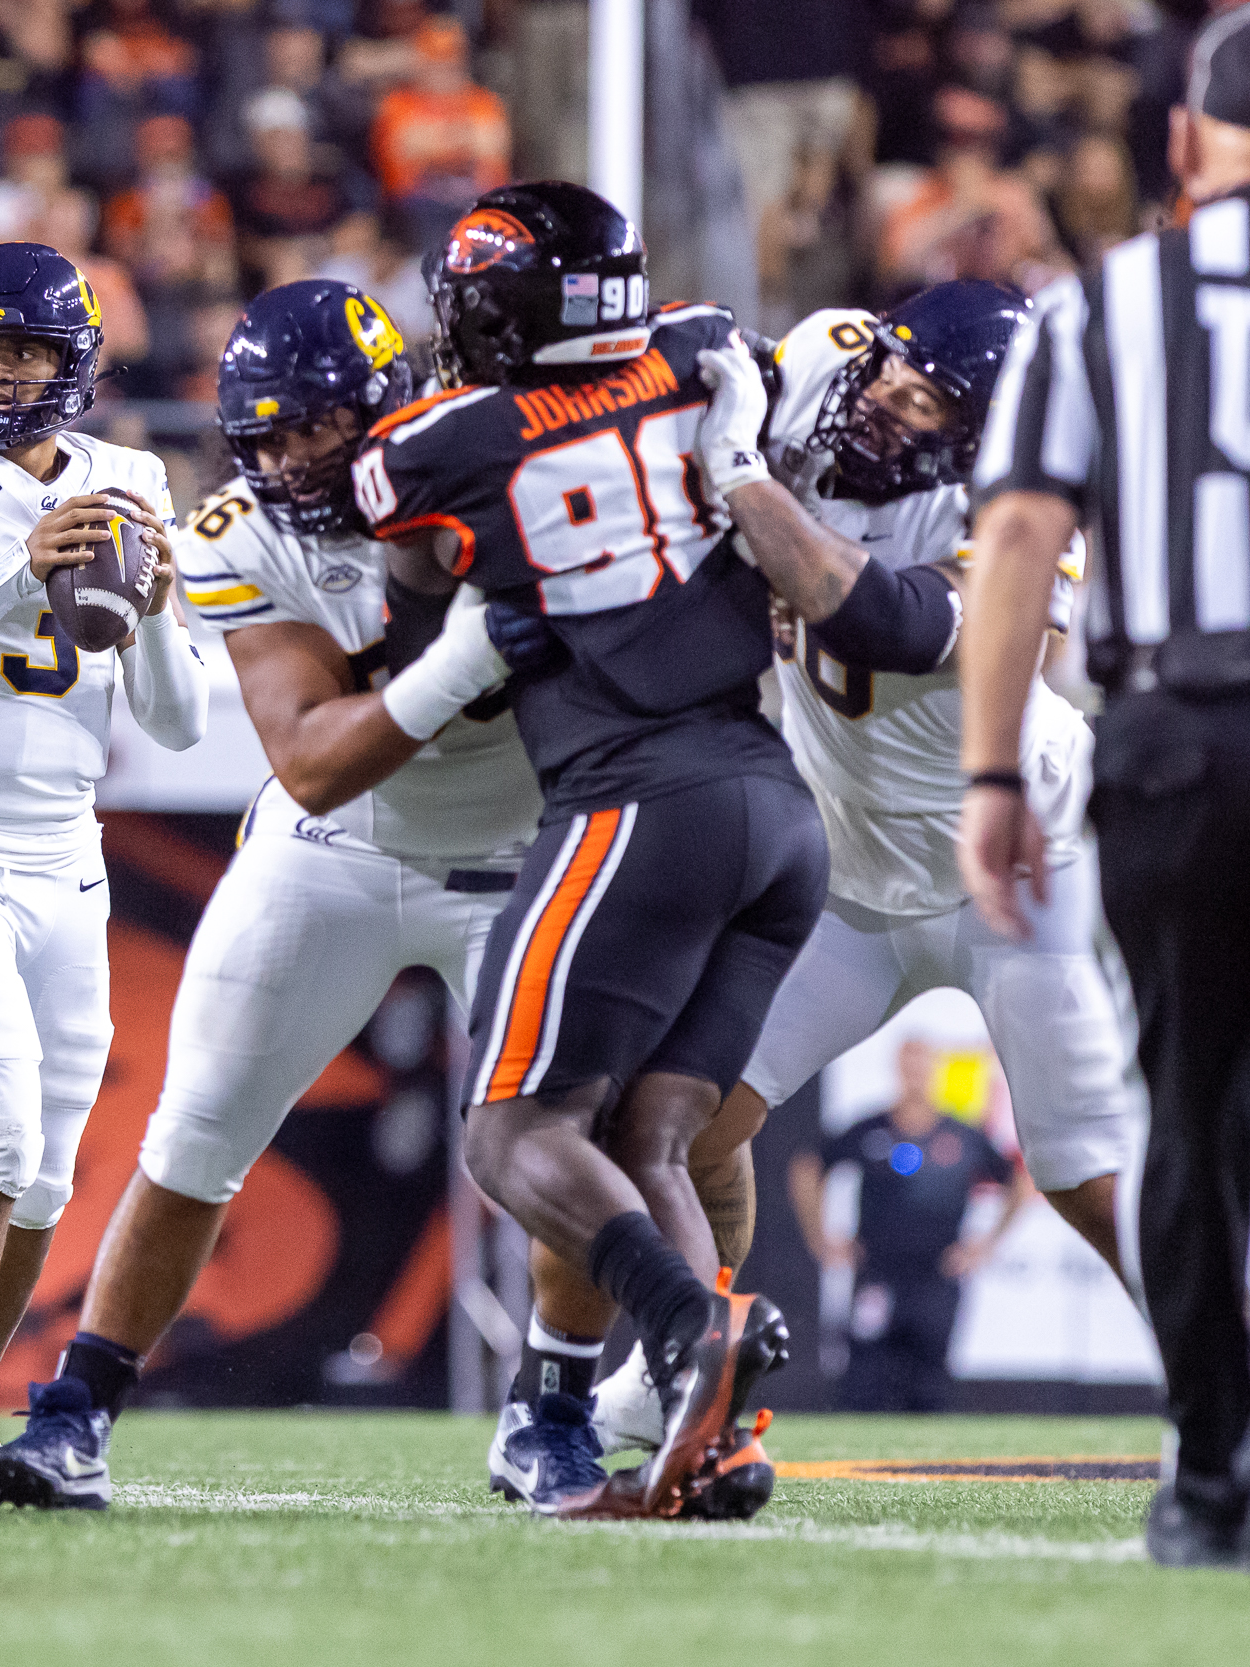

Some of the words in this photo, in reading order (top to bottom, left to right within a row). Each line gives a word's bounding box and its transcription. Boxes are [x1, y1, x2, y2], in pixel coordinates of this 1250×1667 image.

[601, 274, 644, 321] 90
[513, 348, 680, 440] JOHNSON
[41, 495, 58, 512] Cal
[507, 400, 724, 616] 90
[0, 609, 81, 699] 3
